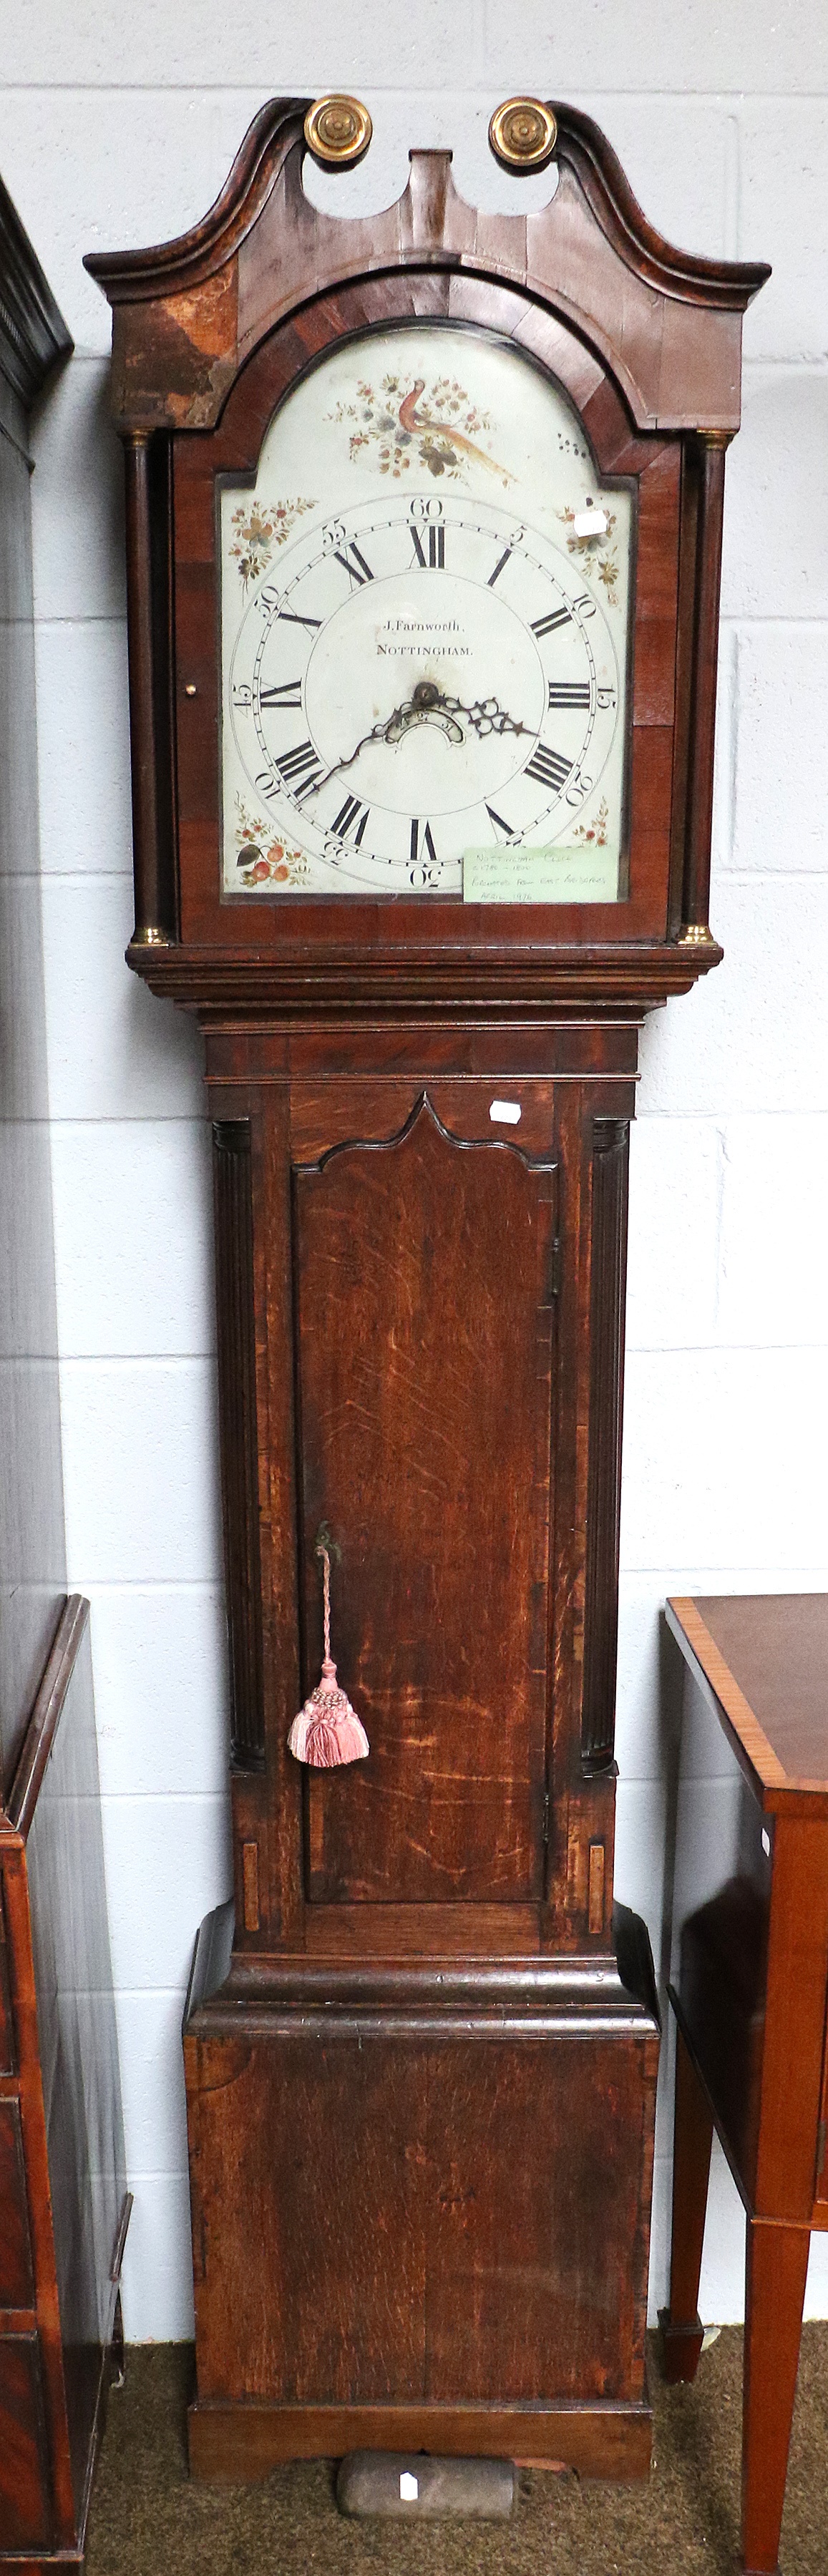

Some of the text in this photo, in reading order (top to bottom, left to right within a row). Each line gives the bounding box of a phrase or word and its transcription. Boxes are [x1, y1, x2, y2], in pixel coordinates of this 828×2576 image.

[409, 499, 443, 517] 60
[323, 519, 347, 545] 55
[406, 525, 448, 570] XII
[510, 525, 527, 542] 5
[333, 542, 377, 594] XI
[254, 585, 279, 619] 50
[573, 593, 597, 619] 10
[277, 600, 323, 641] X
[527, 604, 574, 641] II
[376, 644, 473, 655] NOTTINGHAM.
[233, 684, 251, 717] 45
[259, 677, 303, 711] IX
[548, 680, 591, 711] III
[598, 685, 615, 709] 15
[521, 742, 575, 795] IIII
[254, 772, 282, 803] 40
[565, 772, 593, 807] 20
[329, 794, 371, 849] VII
[320, 841, 349, 865] 35
[407, 819, 437, 862] VI
[409, 868, 441, 887] 30
